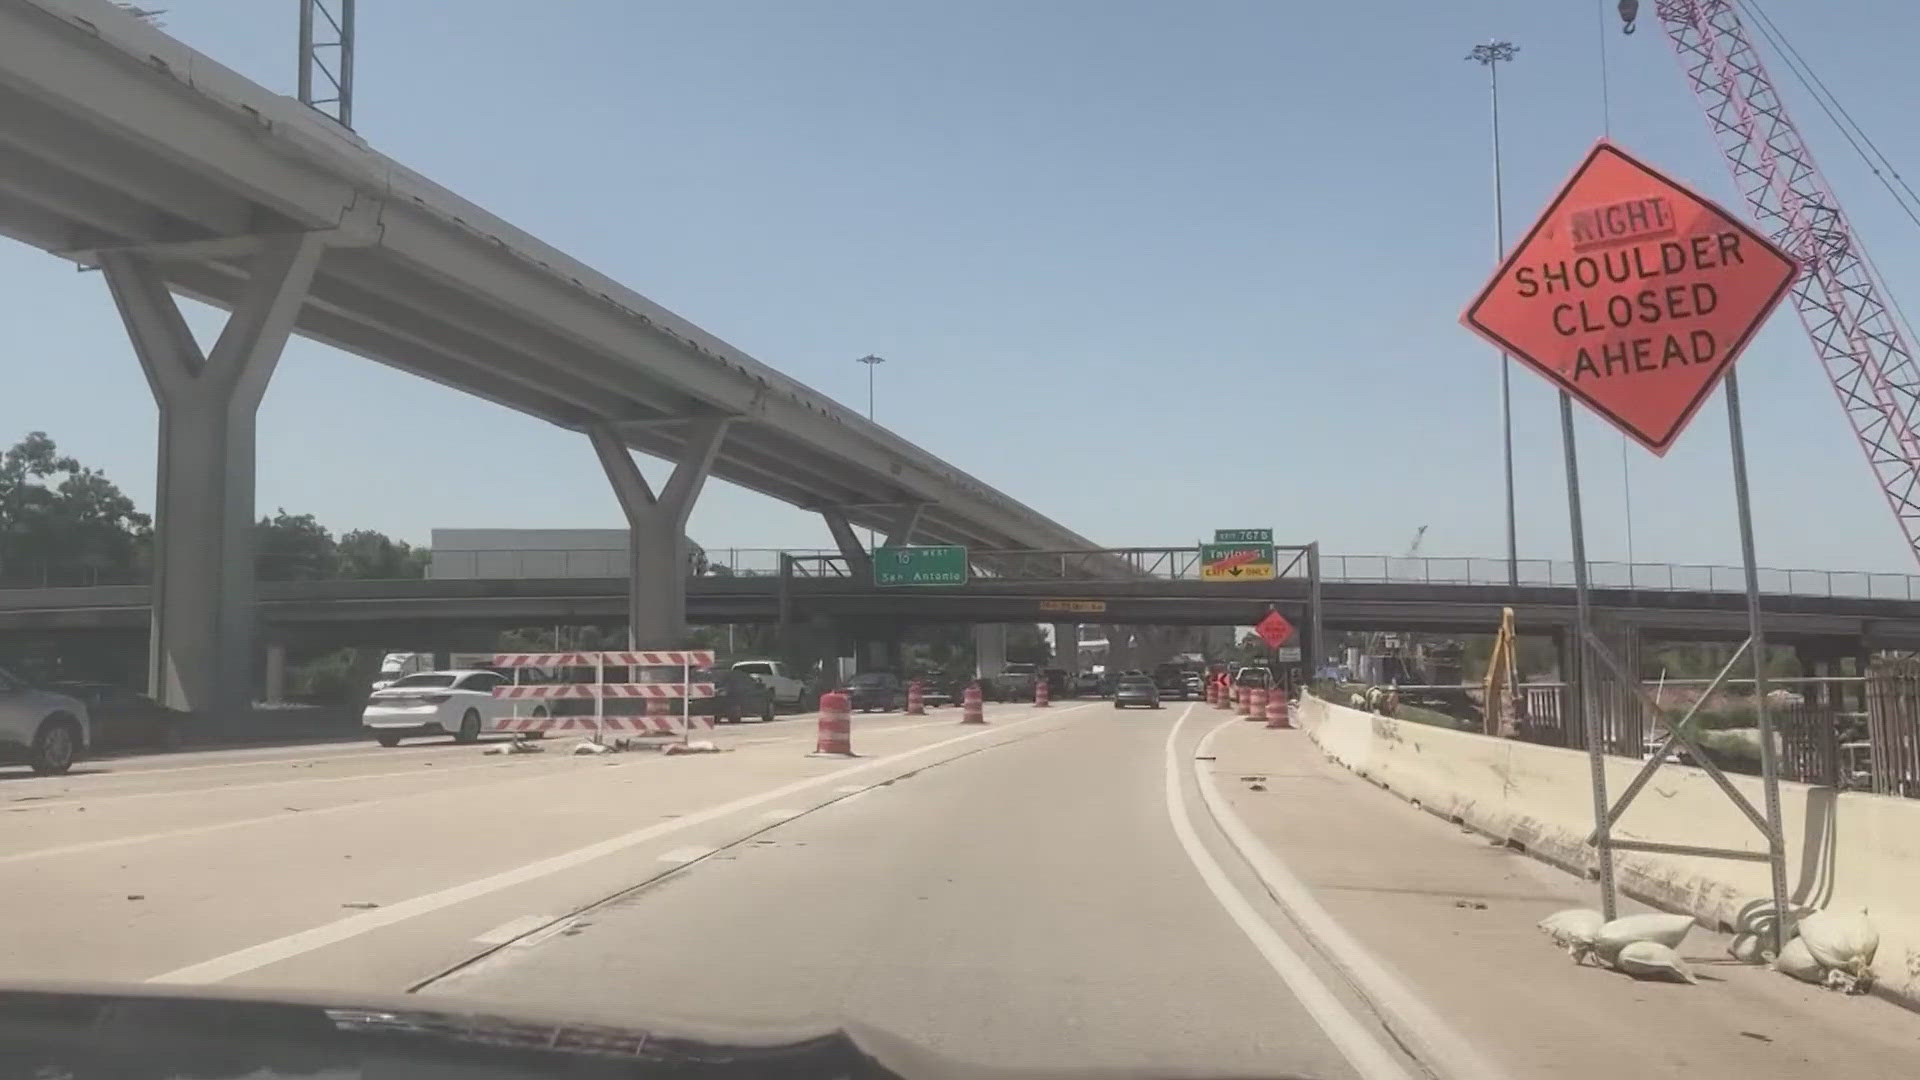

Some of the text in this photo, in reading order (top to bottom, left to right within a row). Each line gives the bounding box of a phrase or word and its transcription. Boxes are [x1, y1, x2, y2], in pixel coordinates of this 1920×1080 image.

[1572, 198, 1665, 243] RIGHT
[1515, 232, 1744, 298] SHOULDER
[1552, 282, 1718, 336] CLOSED
[1573, 329, 1717, 382] AHEAD
[898, 553, 910, 564] 10
[1210, 549, 1247, 560] Taylor
[882, 572, 961, 582] San Antonio
[1245, 567, 1270, 577] ONLY
